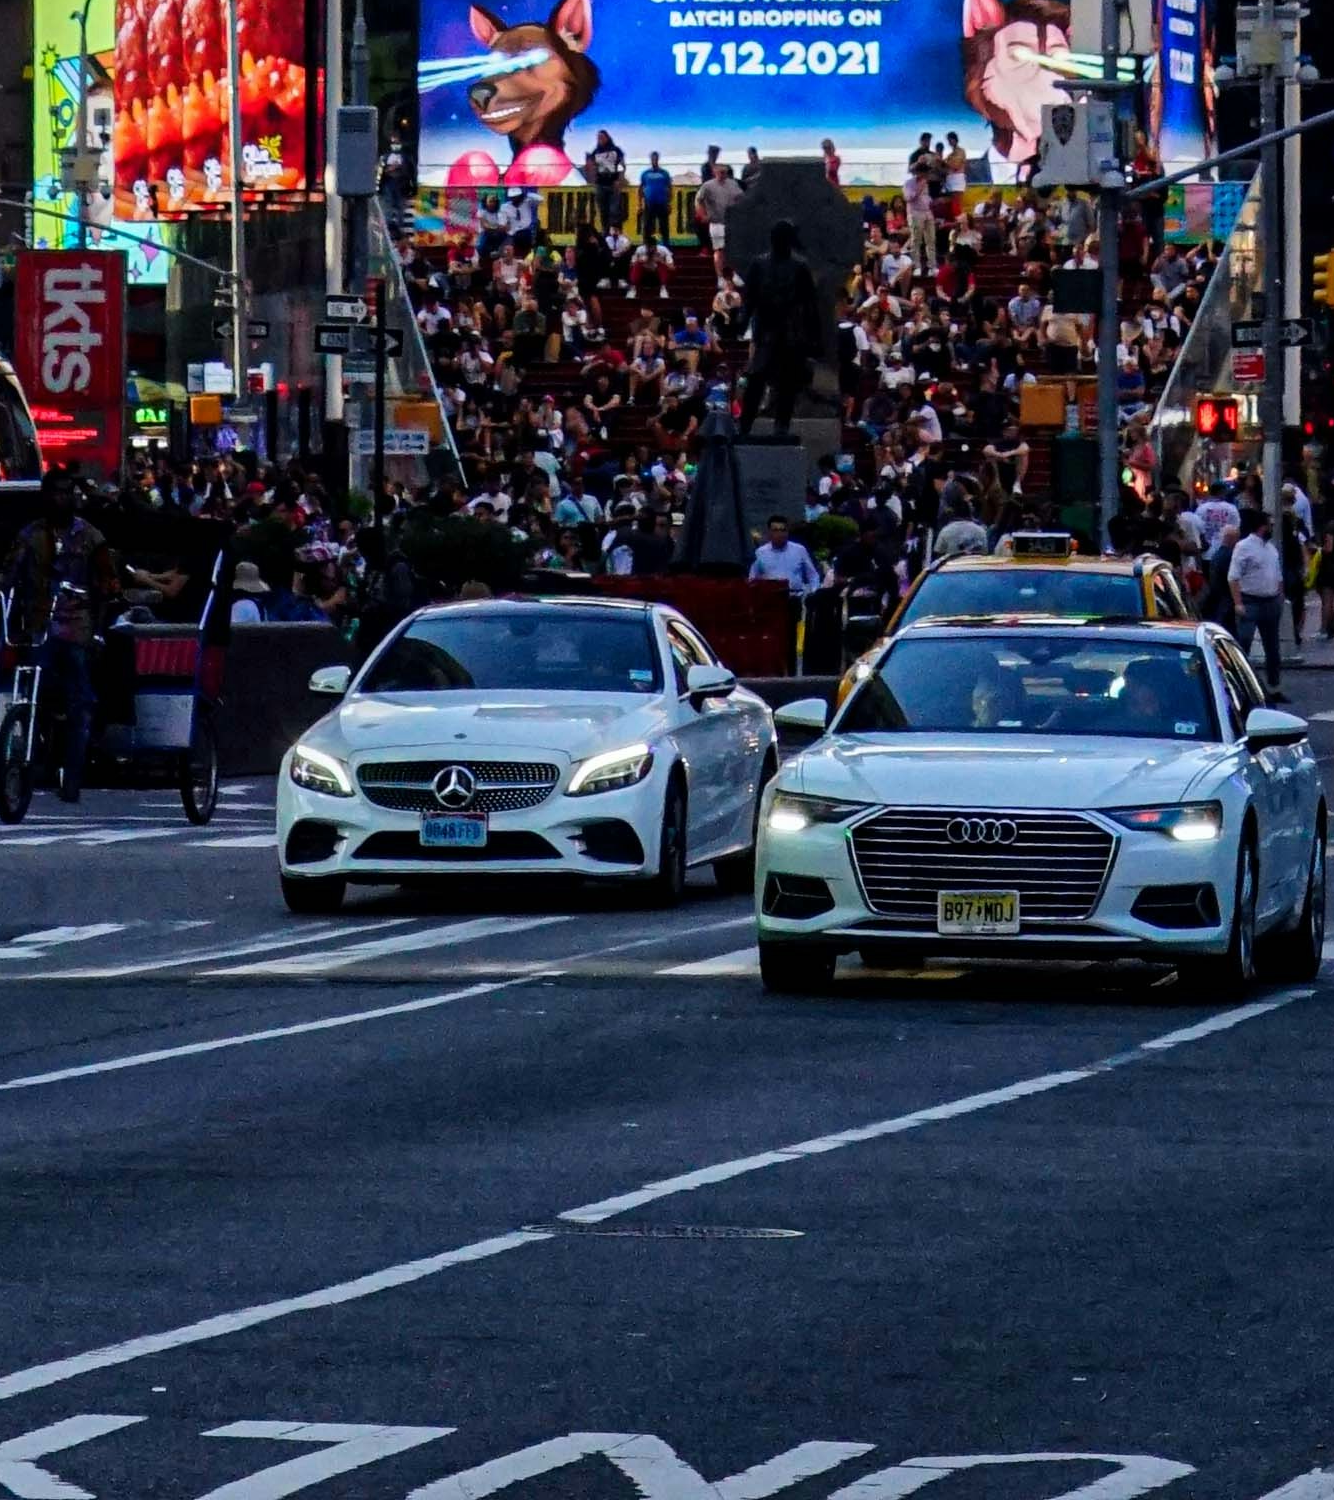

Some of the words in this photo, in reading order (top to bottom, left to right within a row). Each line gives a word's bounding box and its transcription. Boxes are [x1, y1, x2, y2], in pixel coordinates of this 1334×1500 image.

[669, 10, 734, 27] BATCH
[738, 9, 844, 27] DROPPING
[848, 8, 882, 26] ON
[672, 41, 880, 76] 17.12.2021
[42, 263, 106, 393] tkts
